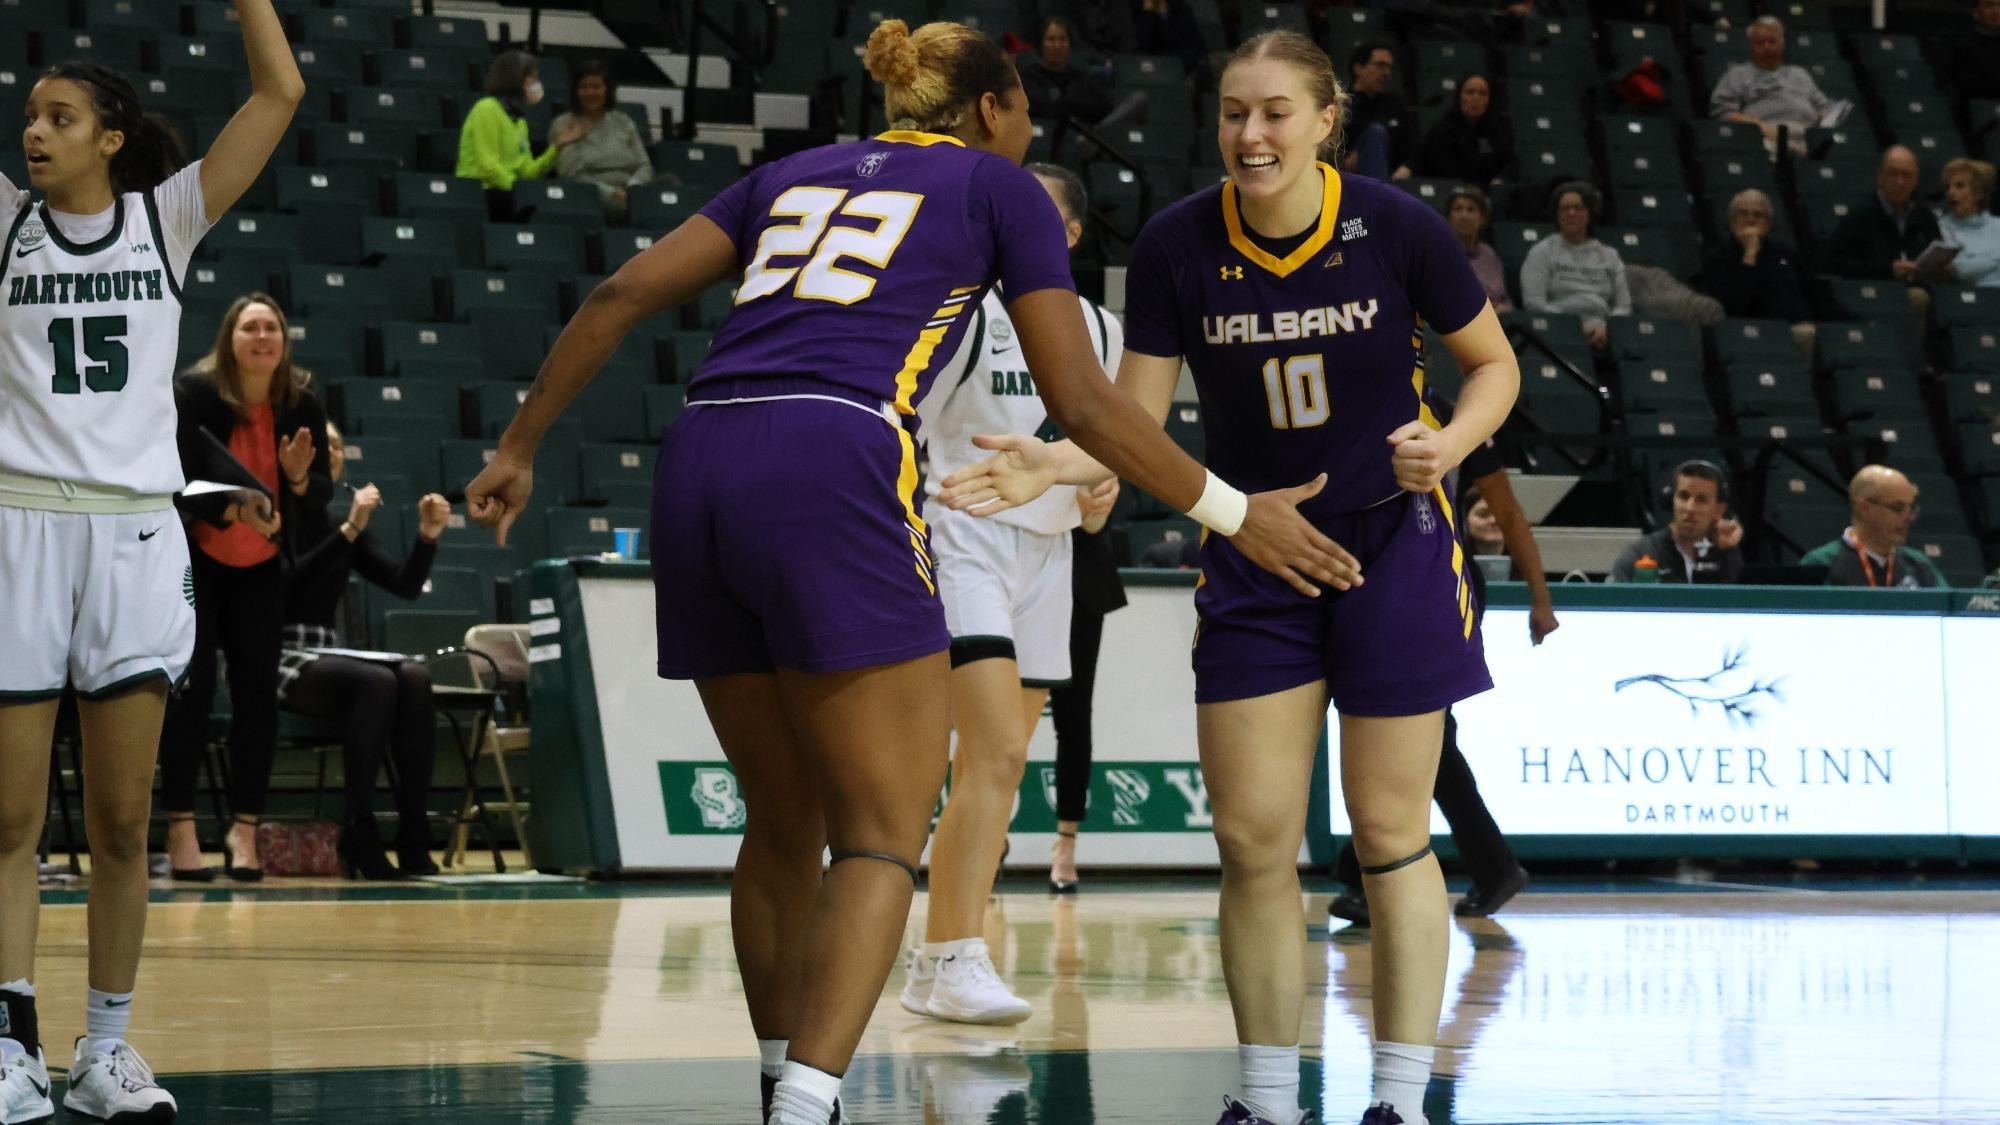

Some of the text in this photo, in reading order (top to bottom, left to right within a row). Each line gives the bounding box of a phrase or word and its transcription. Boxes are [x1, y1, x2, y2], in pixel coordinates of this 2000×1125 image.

[1341, 217, 1362, 228] BLACK
[1341, 229, 1368, 241] MATTER
[1343, 224, 1363, 234] LIVES
[734, 187, 925, 305] 22
[8, 269, 163, 306] DARTMOUTH
[1202, 298, 1379, 344] UALBANY
[48, 315, 129, 394] 15
[991, 371, 1041, 396] DAR
[1262, 354, 1331, 430] 10
[1519, 746, 1895, 788] HANOVER INN
[1626, 804, 1790, 823] DARTMOUTH
